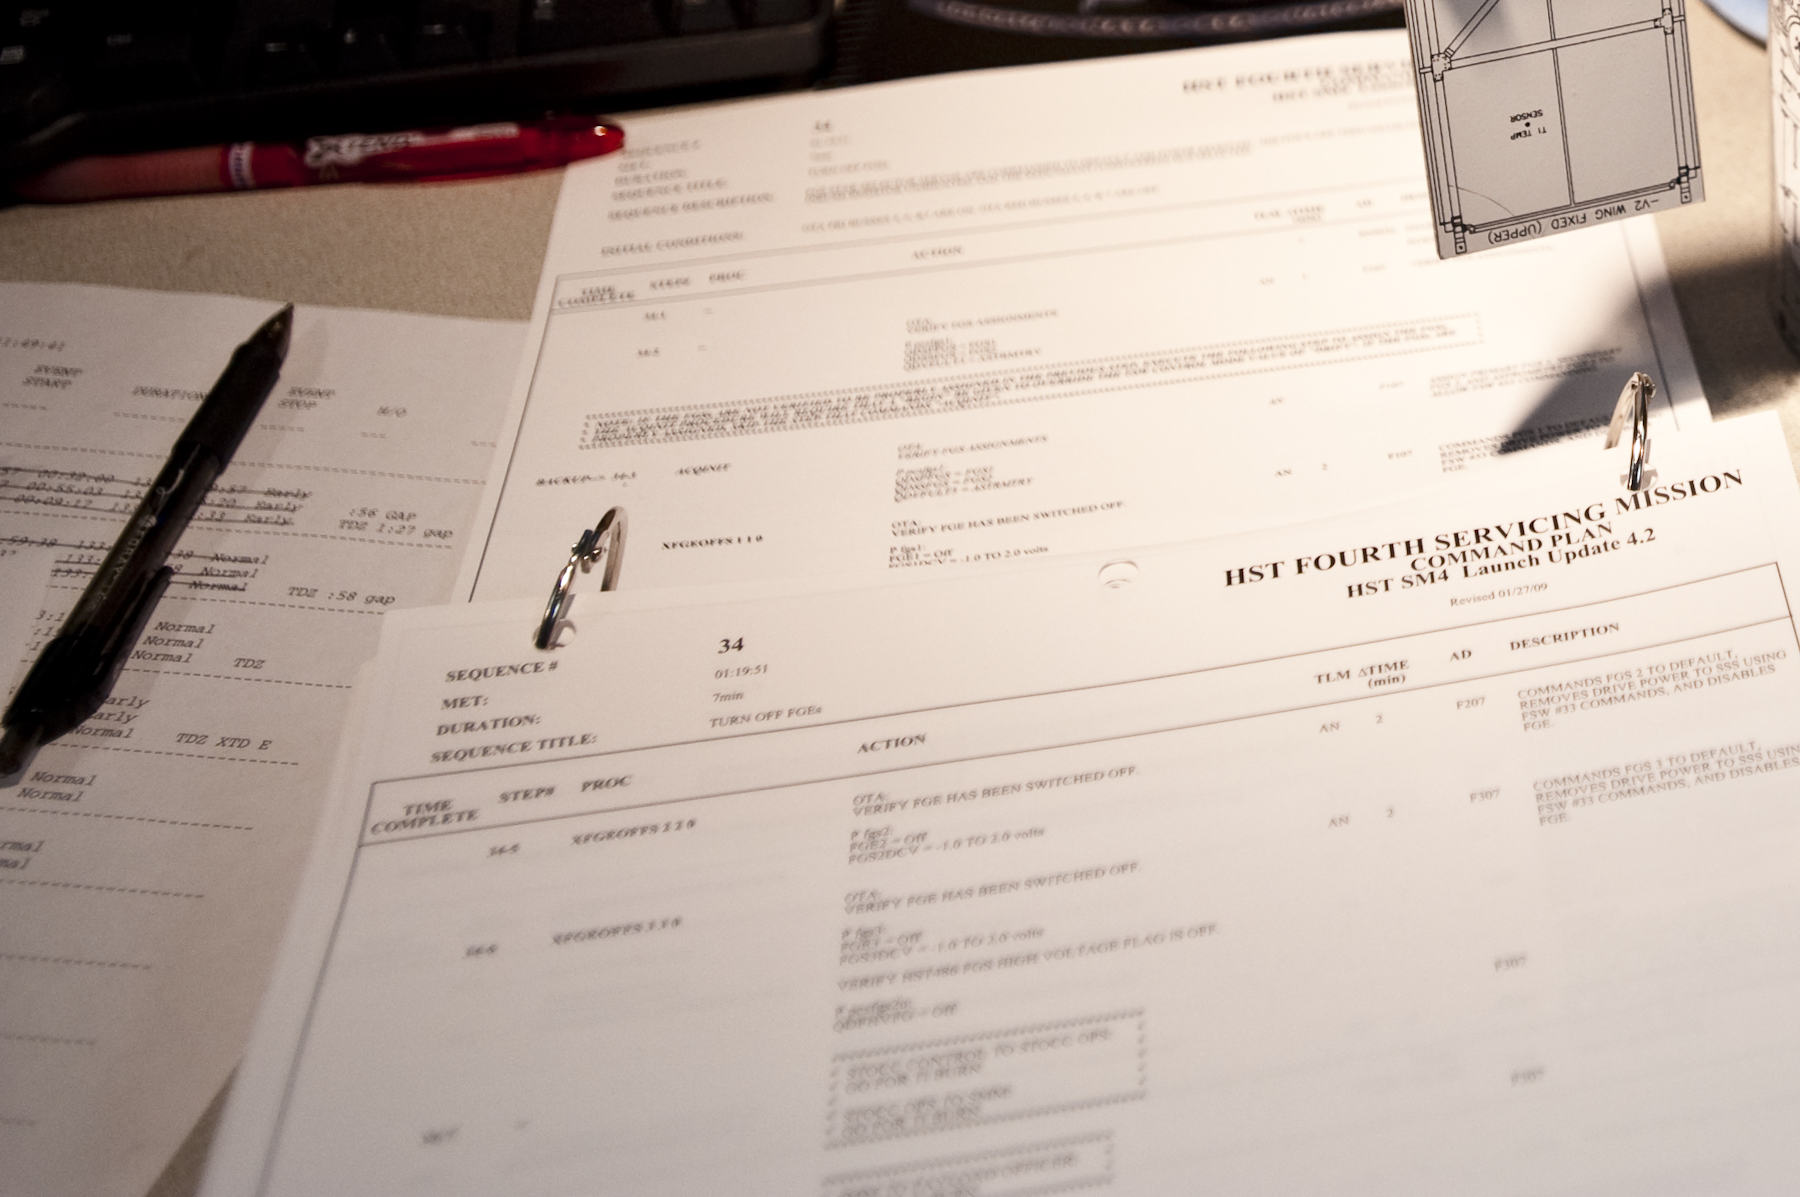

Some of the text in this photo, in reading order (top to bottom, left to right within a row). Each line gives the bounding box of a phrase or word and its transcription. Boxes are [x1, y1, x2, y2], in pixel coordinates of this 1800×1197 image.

[1509, 108, 1543, 123] SENSOR
[1509, 129, 1531, 140] TEMP
[1550, 212, 1587, 229] FIXED
[1594, 204, 1627, 219] WING
[1486, 219, 1543, 245] (UPPER)
[1225, 469, 1743, 587] HST FOURTH SERVICING MISSION
[1410, 523, 1612, 576] COMMAND PLAN
[1347, 527, 1656, 598] HST SM4 Launch Update 4.2
[287, 586, 319, 599] TDZ
[363, 594, 395, 606] gap
[1449, 582, 1548, 608] Revised 01/27/09
[153, 620, 216, 635] Normal
[1509, 622, 1619, 651] DESCRIPTION
[142, 634, 204, 649] Normal
[717, 637, 745, 654] 34
[130, 648, 265, 670] Normal TDZ
[1450, 649, 1472, 661] AD
[444, 660, 559, 683] SEQUENCE #
[714, 663, 768, 680] 01:19:51
[1316, 669, 1351, 685] TLM
[1517, 649, 1739, 699] COMMANDS FGS 2 TO DEFAULT,
[1519, 650, 1787, 711] REMOVES DRIVE POWER TO SSS USING
[1367, 674, 1406, 689] (min)
[1521, 707, 1551, 722] FSW
[1579, 686, 1670, 711] COMMANDS,
[1673, 679, 1704, 693] AND
[1706, 663, 1776, 687] DISABLES
[440, 694, 489, 711] MET:
[1456, 696, 1486, 711] F207
[436, 714, 541, 737] DURATION:
[708, 713, 752, 729] TURN
[755, 709, 784, 722] OFF
[1319, 721, 1341, 734] AN
[1375, 713, 1383, 725] 2
[174, 732, 273, 750] TDZ XTD E
[429, 733, 597, 764] SEQUENCE TITLE:
[857, 733, 926, 754] ACTION
[580, 775, 631, 793] PROC
[852, 799, 909, 817] VERIFY
[946, 789, 979, 804] HAS
[981, 783, 1022, 799] BEEN
[1025, 771, 1105, 792] SWITCHED
[403, 799, 452, 817] TIME
[369, 808, 480, 836] COMPLETE
